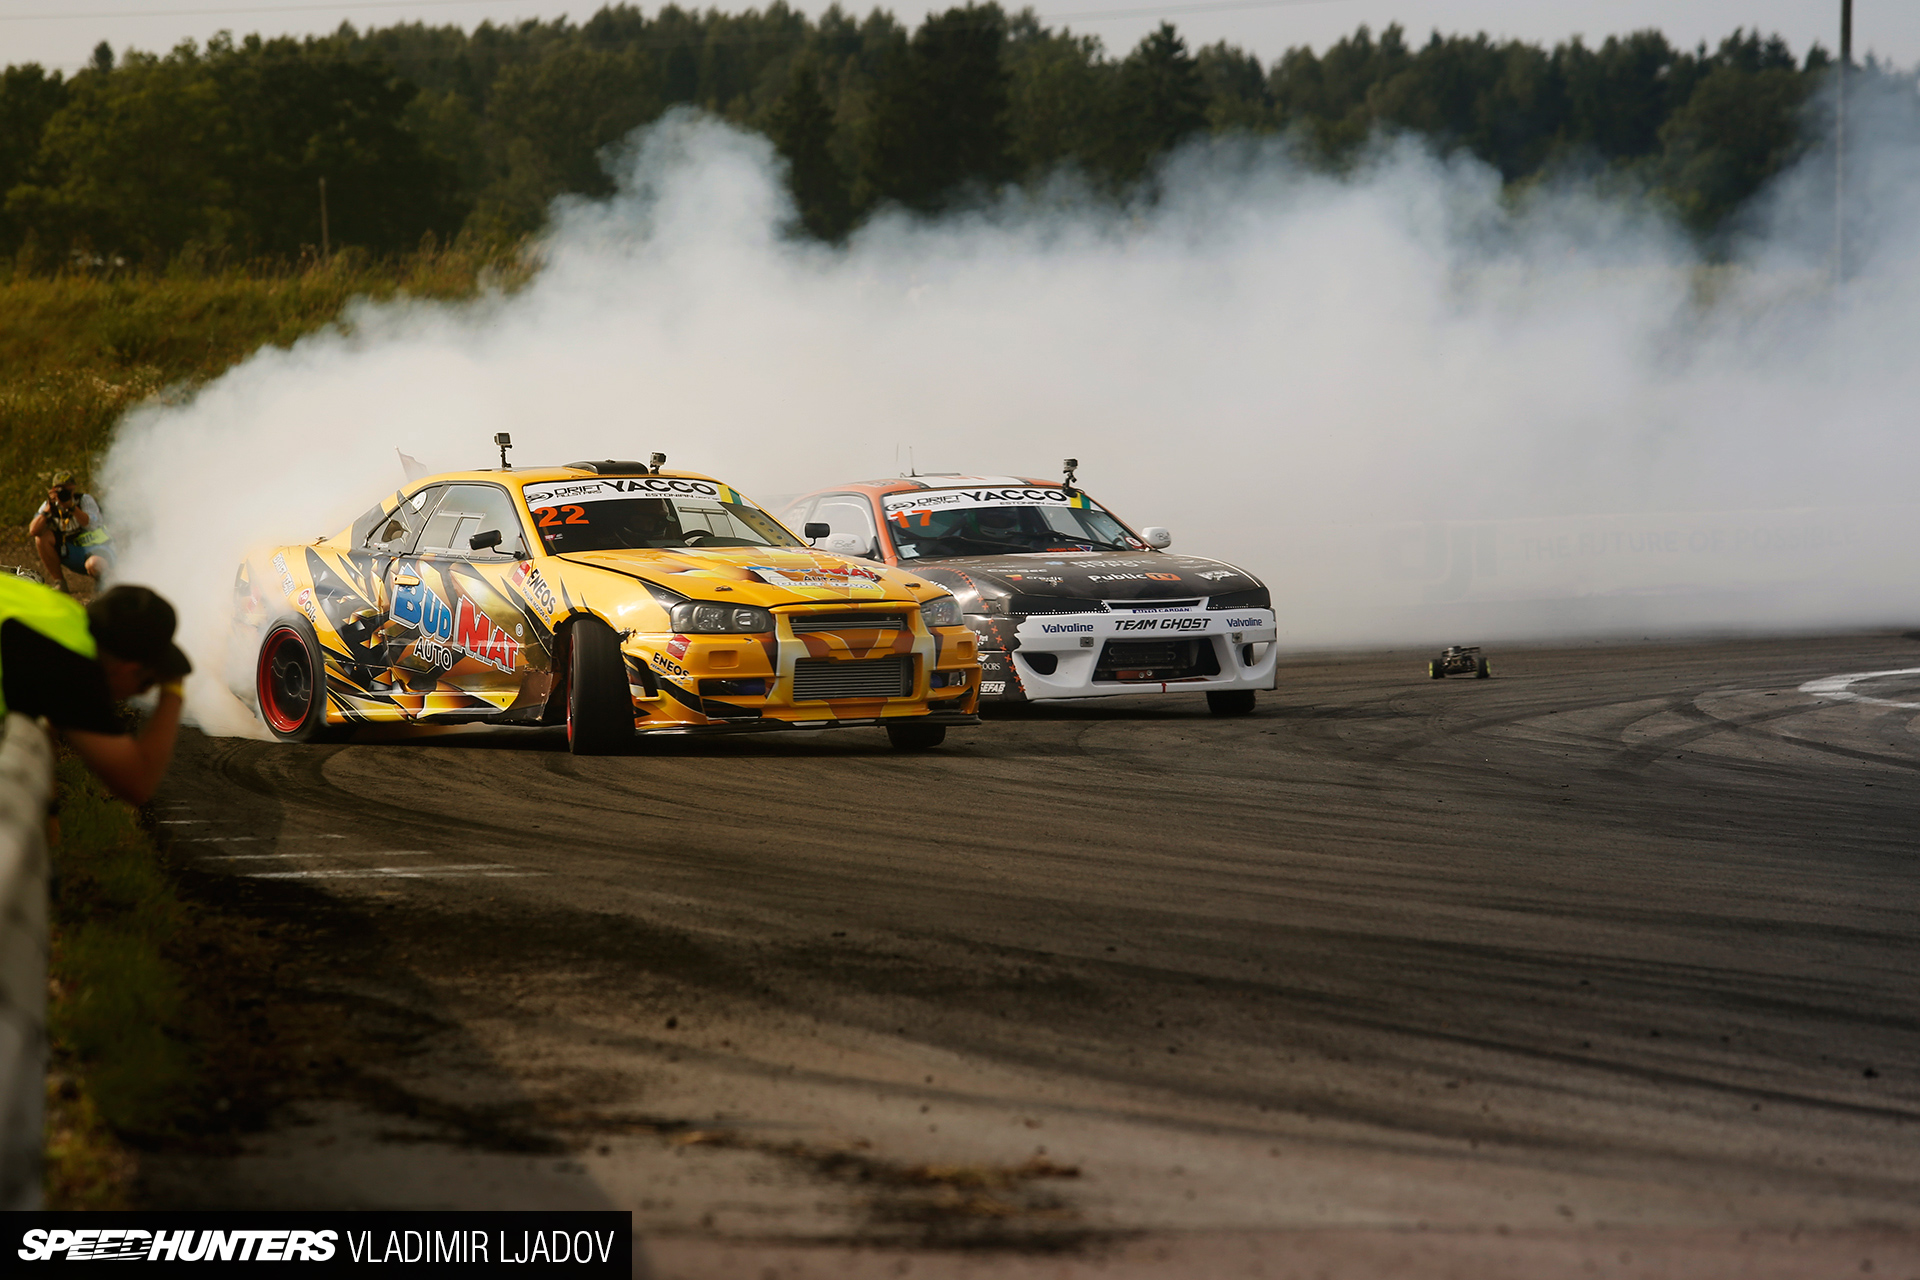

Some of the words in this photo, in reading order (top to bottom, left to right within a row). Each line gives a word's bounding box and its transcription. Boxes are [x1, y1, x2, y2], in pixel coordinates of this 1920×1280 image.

[554, 484, 603, 495] DRIFT
[600, 480, 717, 495] YACCO
[917, 495, 962, 505] DRIFT
[960, 490, 1067, 501] YACCO
[533, 504, 590, 528] 22
[890, 509, 933, 528] 17
[1520, 536, 1572, 562] THE
[1578, 530, 1680, 557] FUTURE
[1687, 528, 1726, 553] OF
[1088, 573, 1147, 582] Public
[526, 568, 556, 614] ENEOS
[305, 600, 317, 623] Oils
[1042, 622, 1094, 633] Valvoline
[1114, 619, 1158, 631] TEAM
[1160, 618, 1212, 630] GHOST
[1226, 617, 1263, 628] Valvoline
[452, 594, 520, 675] MAT
[413, 636, 453, 671] AUTO
[652, 652, 690, 680] ENEOS
[978, 662, 1001, 671] OORS
